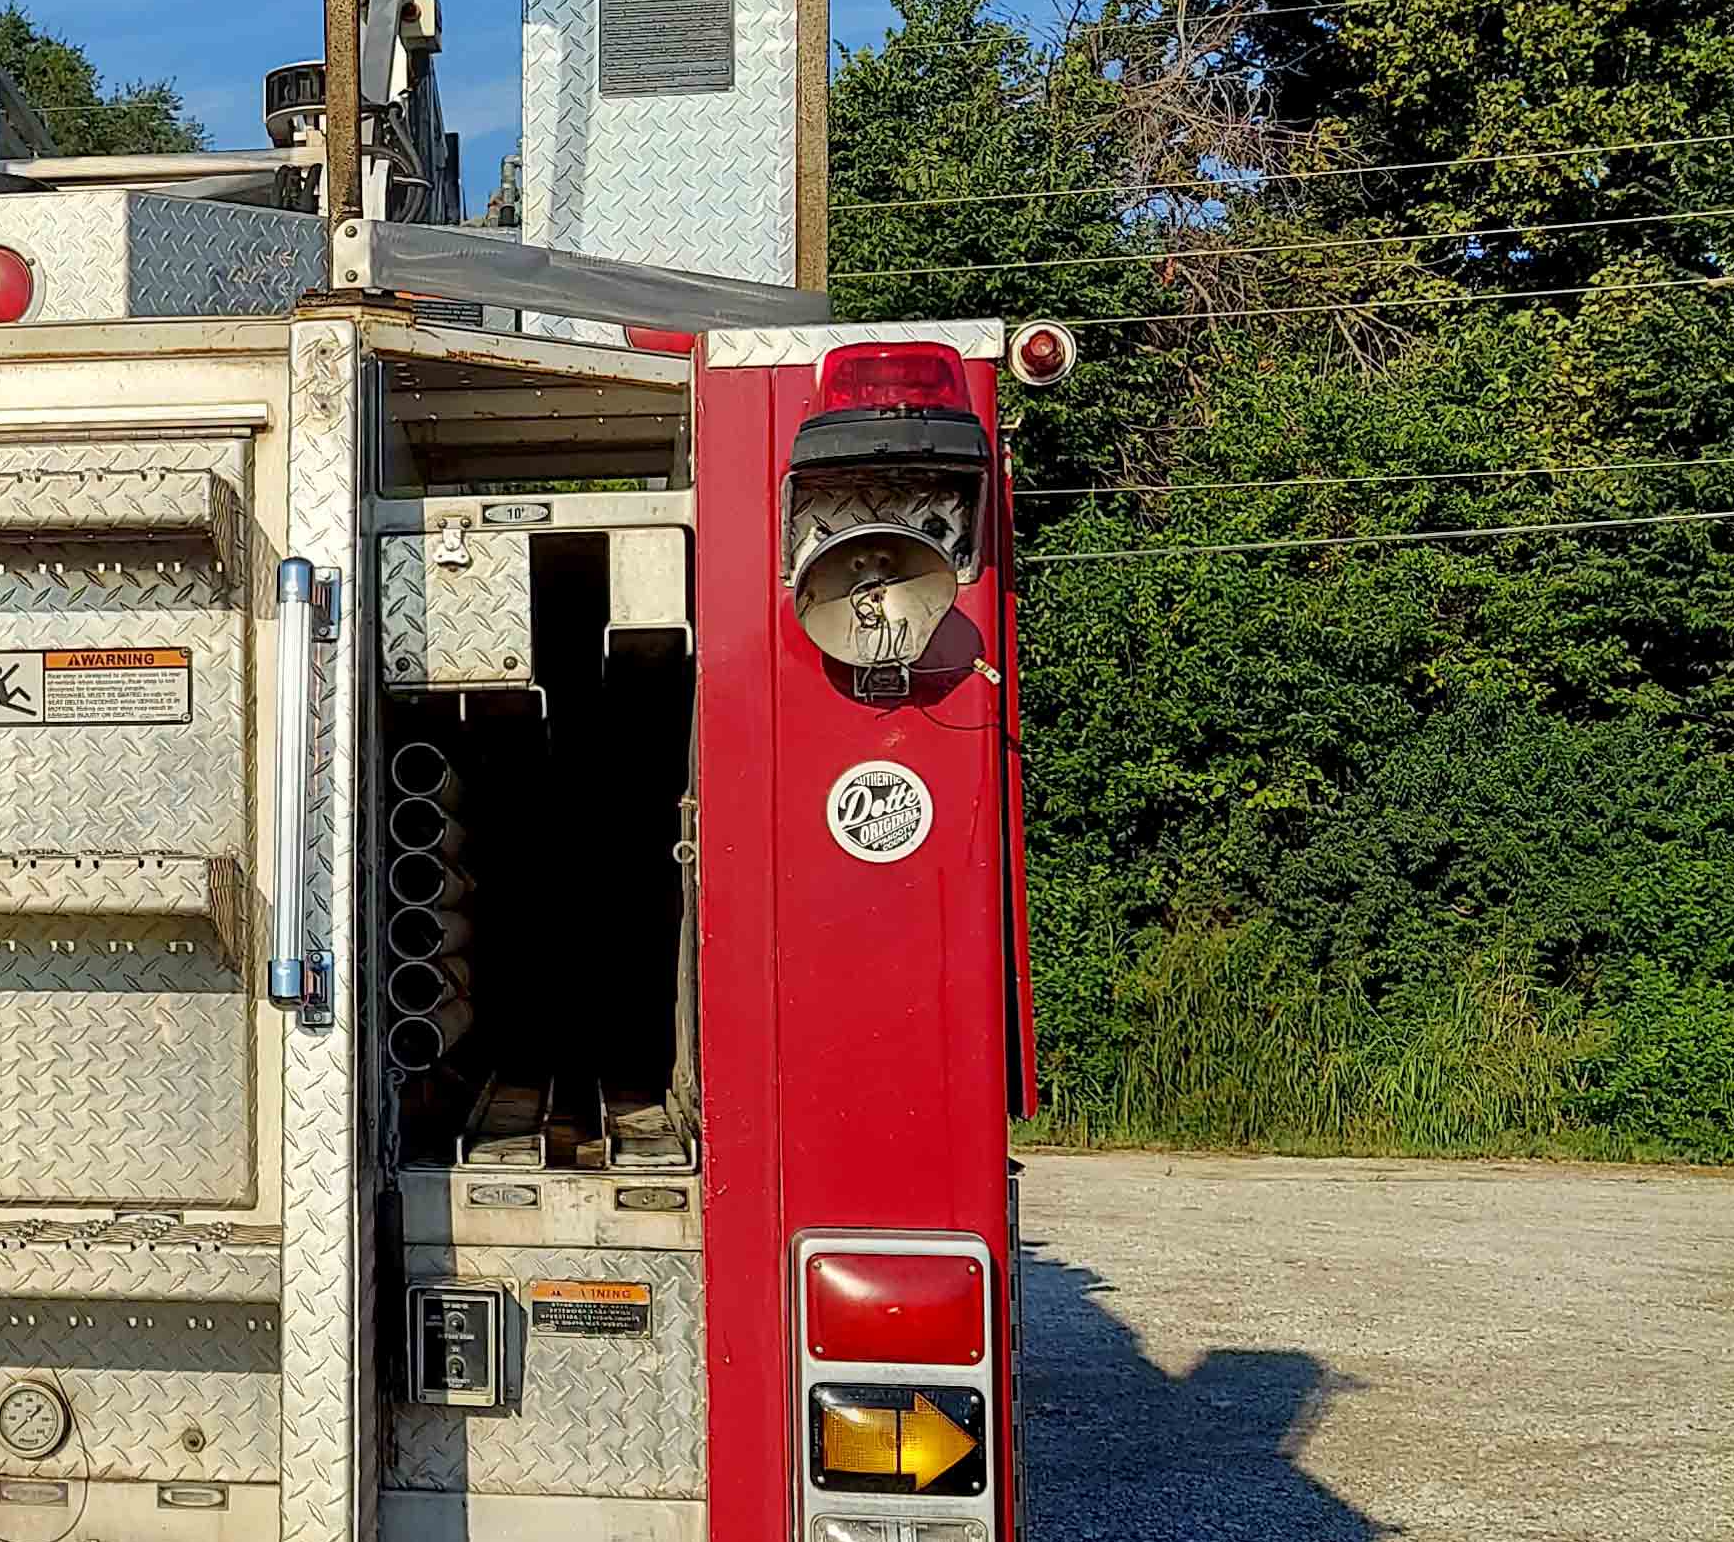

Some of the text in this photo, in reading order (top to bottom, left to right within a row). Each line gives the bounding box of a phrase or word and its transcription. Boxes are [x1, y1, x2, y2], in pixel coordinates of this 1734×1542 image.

[79, 653, 155, 667] WARNING
[853, 772, 903, 787] AUTHENTIC
[839, 782, 922, 827] Dotte
[859, 808, 921, 844] ORIGINAL
